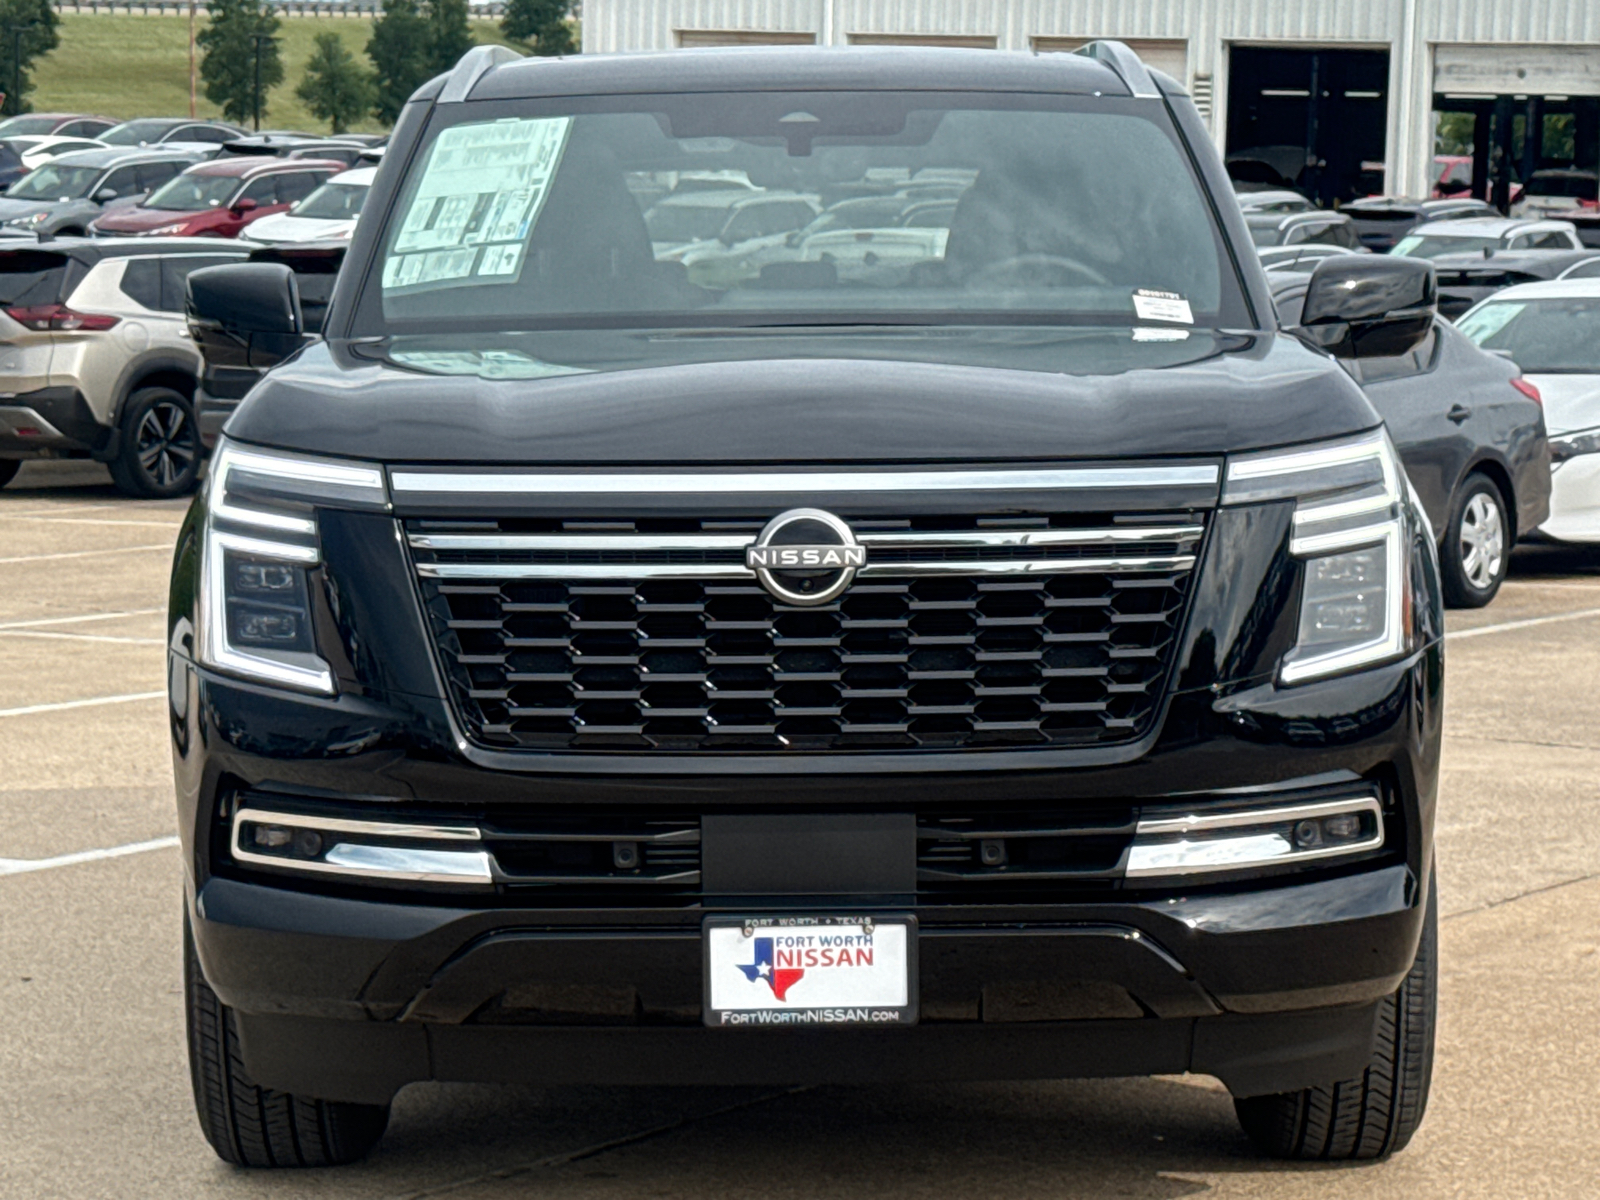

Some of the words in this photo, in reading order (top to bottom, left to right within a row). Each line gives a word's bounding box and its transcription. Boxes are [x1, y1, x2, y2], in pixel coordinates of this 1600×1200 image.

[749, 549, 864, 565] NISSAN
[745, 919, 774, 927] FORT
[779, 918, 819, 926] WORTH
[836, 917, 872, 925] TEXAS
[776, 936, 815, 947] FORT
[819, 935, 873, 947] WORTH
[776, 948, 873, 967] NISSAN
